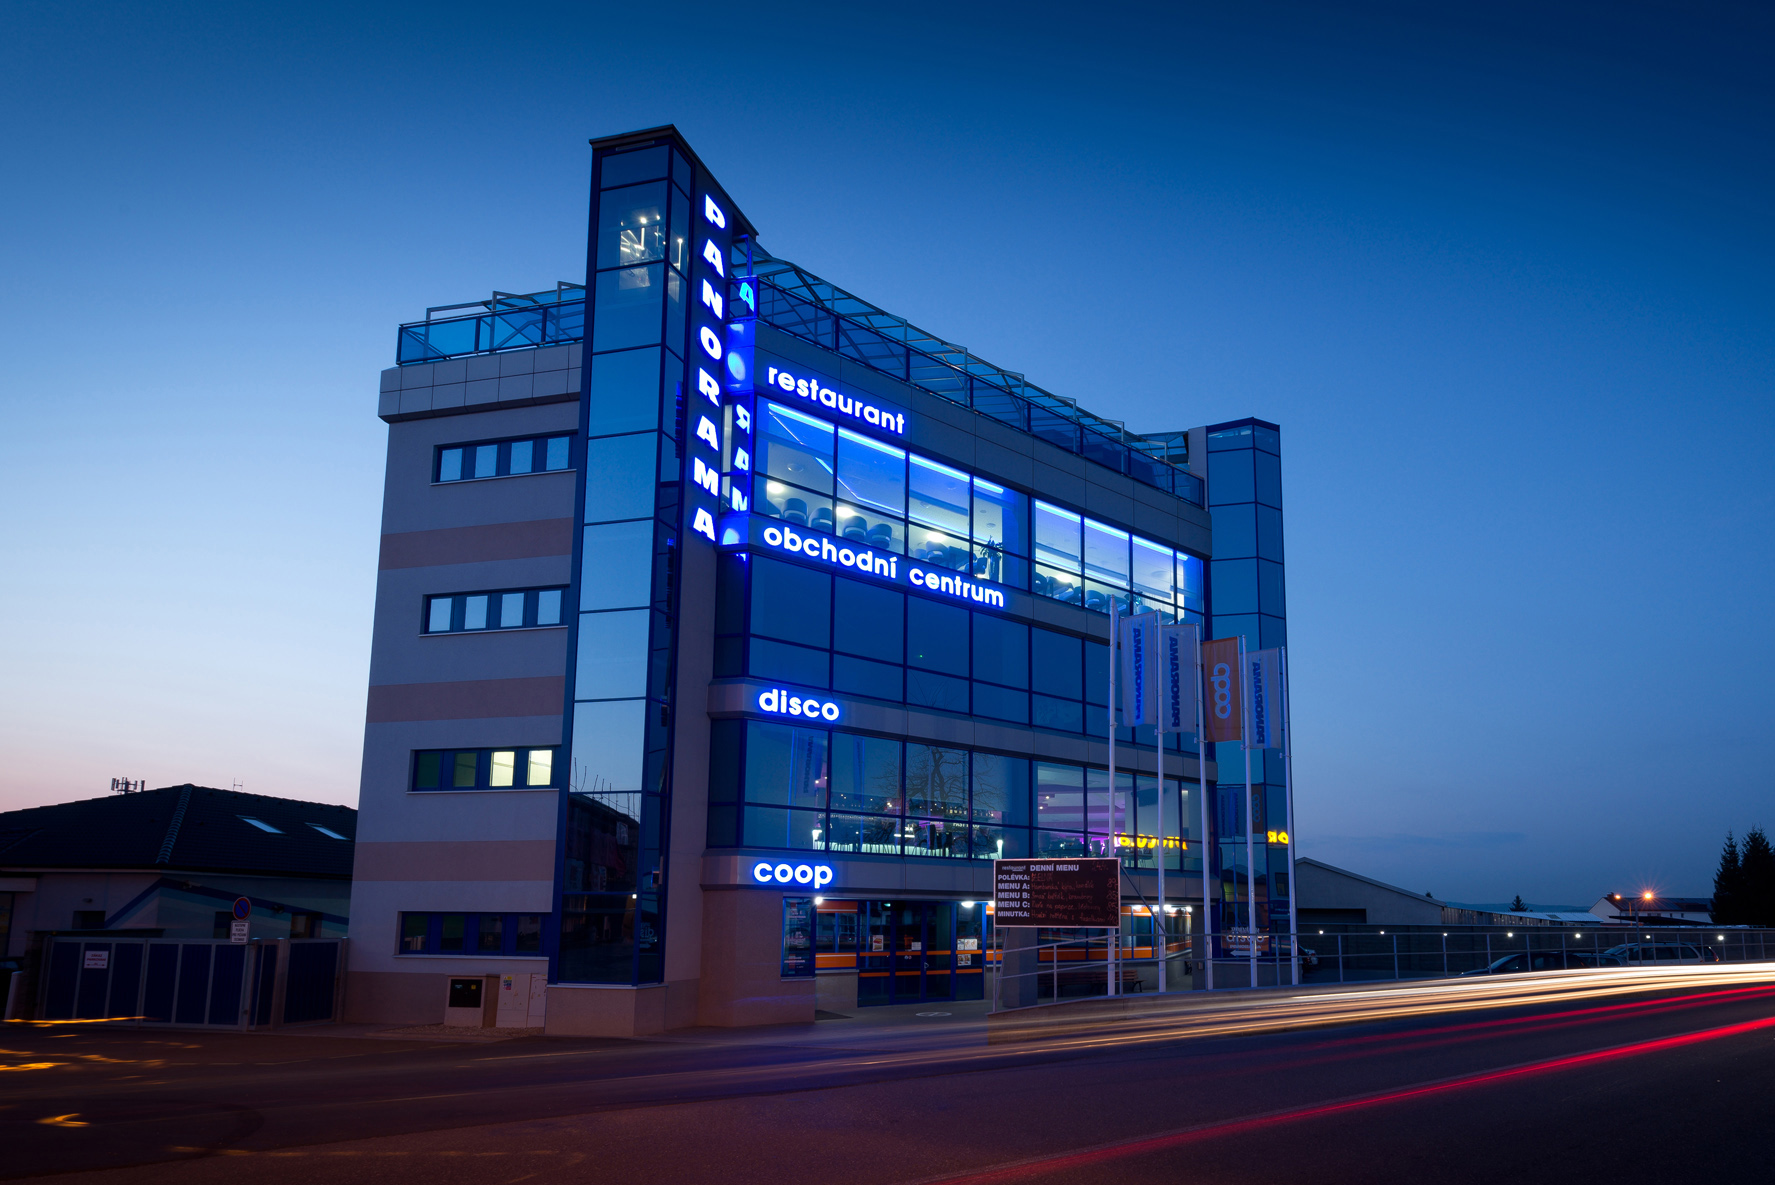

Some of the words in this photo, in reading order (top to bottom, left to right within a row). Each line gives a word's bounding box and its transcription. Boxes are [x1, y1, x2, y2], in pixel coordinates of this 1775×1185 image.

[692, 194, 726, 542] PANORAMA
[768, 366, 905, 434] restaurant
[763, 525, 898, 580] obchodní
[909, 565, 1004, 607] centrum
[758, 689, 840, 721] disco
[753, 862, 833, 889] coop
[998, 873, 1030, 881] POLÉVKA:
[1030, 863, 1054, 872] DENNÍ
[1056, 864, 1080, 872] MENU
[998, 910, 1030, 918] MINUTKA:
